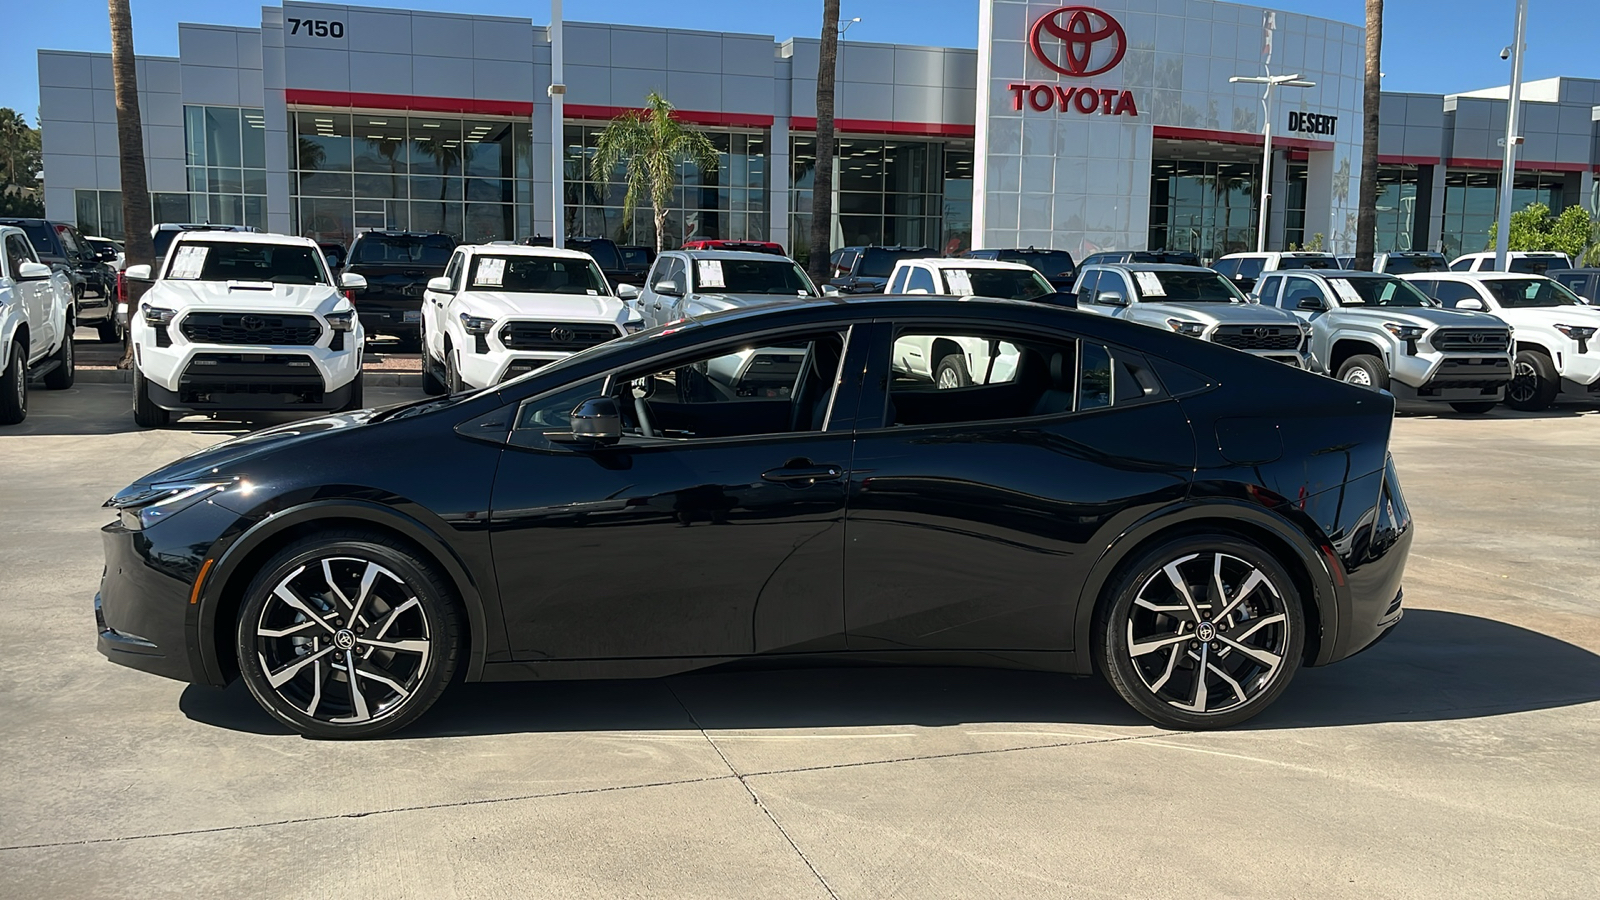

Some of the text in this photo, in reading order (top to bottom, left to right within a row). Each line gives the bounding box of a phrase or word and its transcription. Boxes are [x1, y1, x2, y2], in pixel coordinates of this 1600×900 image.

[287, 18, 345, 39] 7150
[1008, 83, 1138, 117] TOYOTA
[1288, 111, 1338, 136] DESERT
